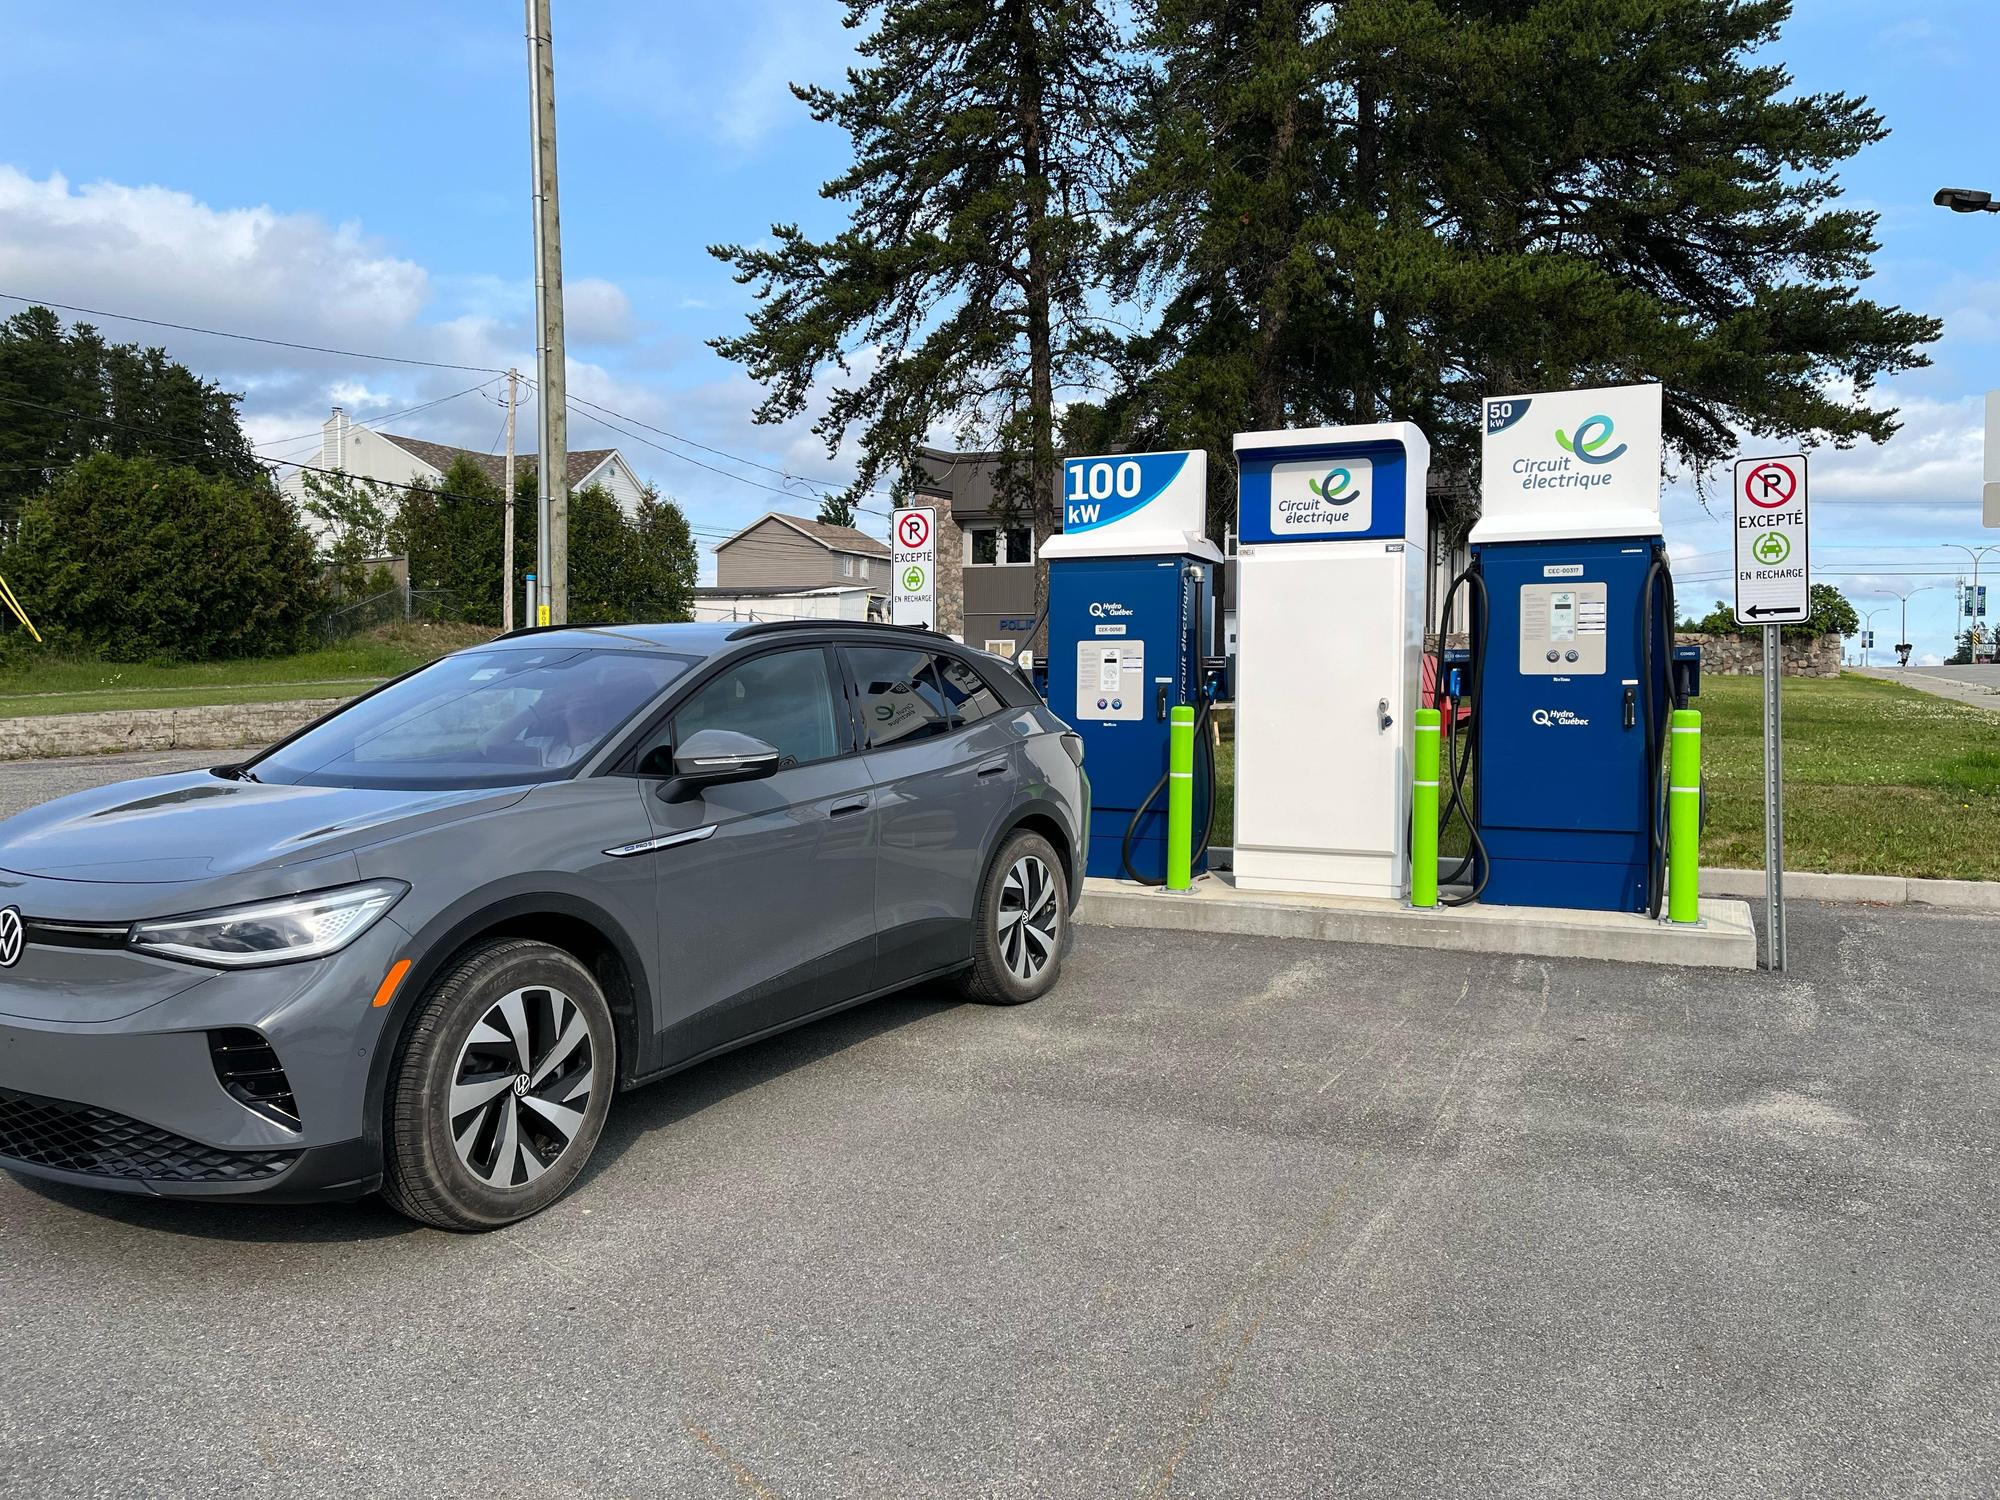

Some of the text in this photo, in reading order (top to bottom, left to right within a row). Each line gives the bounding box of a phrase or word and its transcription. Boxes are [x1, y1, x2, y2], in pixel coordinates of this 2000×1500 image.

[1490, 403, 1512, 419] 50
[1490, 419, 1504, 427] kW
[1512, 456, 1571, 473] Circuit
[1069, 461, 1141, 500] 100
[1522, 472, 1612, 490] électrique
[1279, 499, 1320, 512] Circuit
[1068, 504, 1100, 524] kW
[1285, 511, 1349, 525] électrique
[1739, 510, 1803, 529] EXCEPTÉ
[894, 549, 933, 563] EXCEPTÉ
[1740, 568, 1804, 581] EN RECHARGE
[894, 594, 932, 603] EN RECHARGE
[1102, 602, 1122, 611] Hydro
[1109, 608, 1134, 616] Québec
[1181, 576, 1189, 652] électrique
[1550, 710, 1574, 719] Hydro
[1558, 717, 1589, 725] Québec
